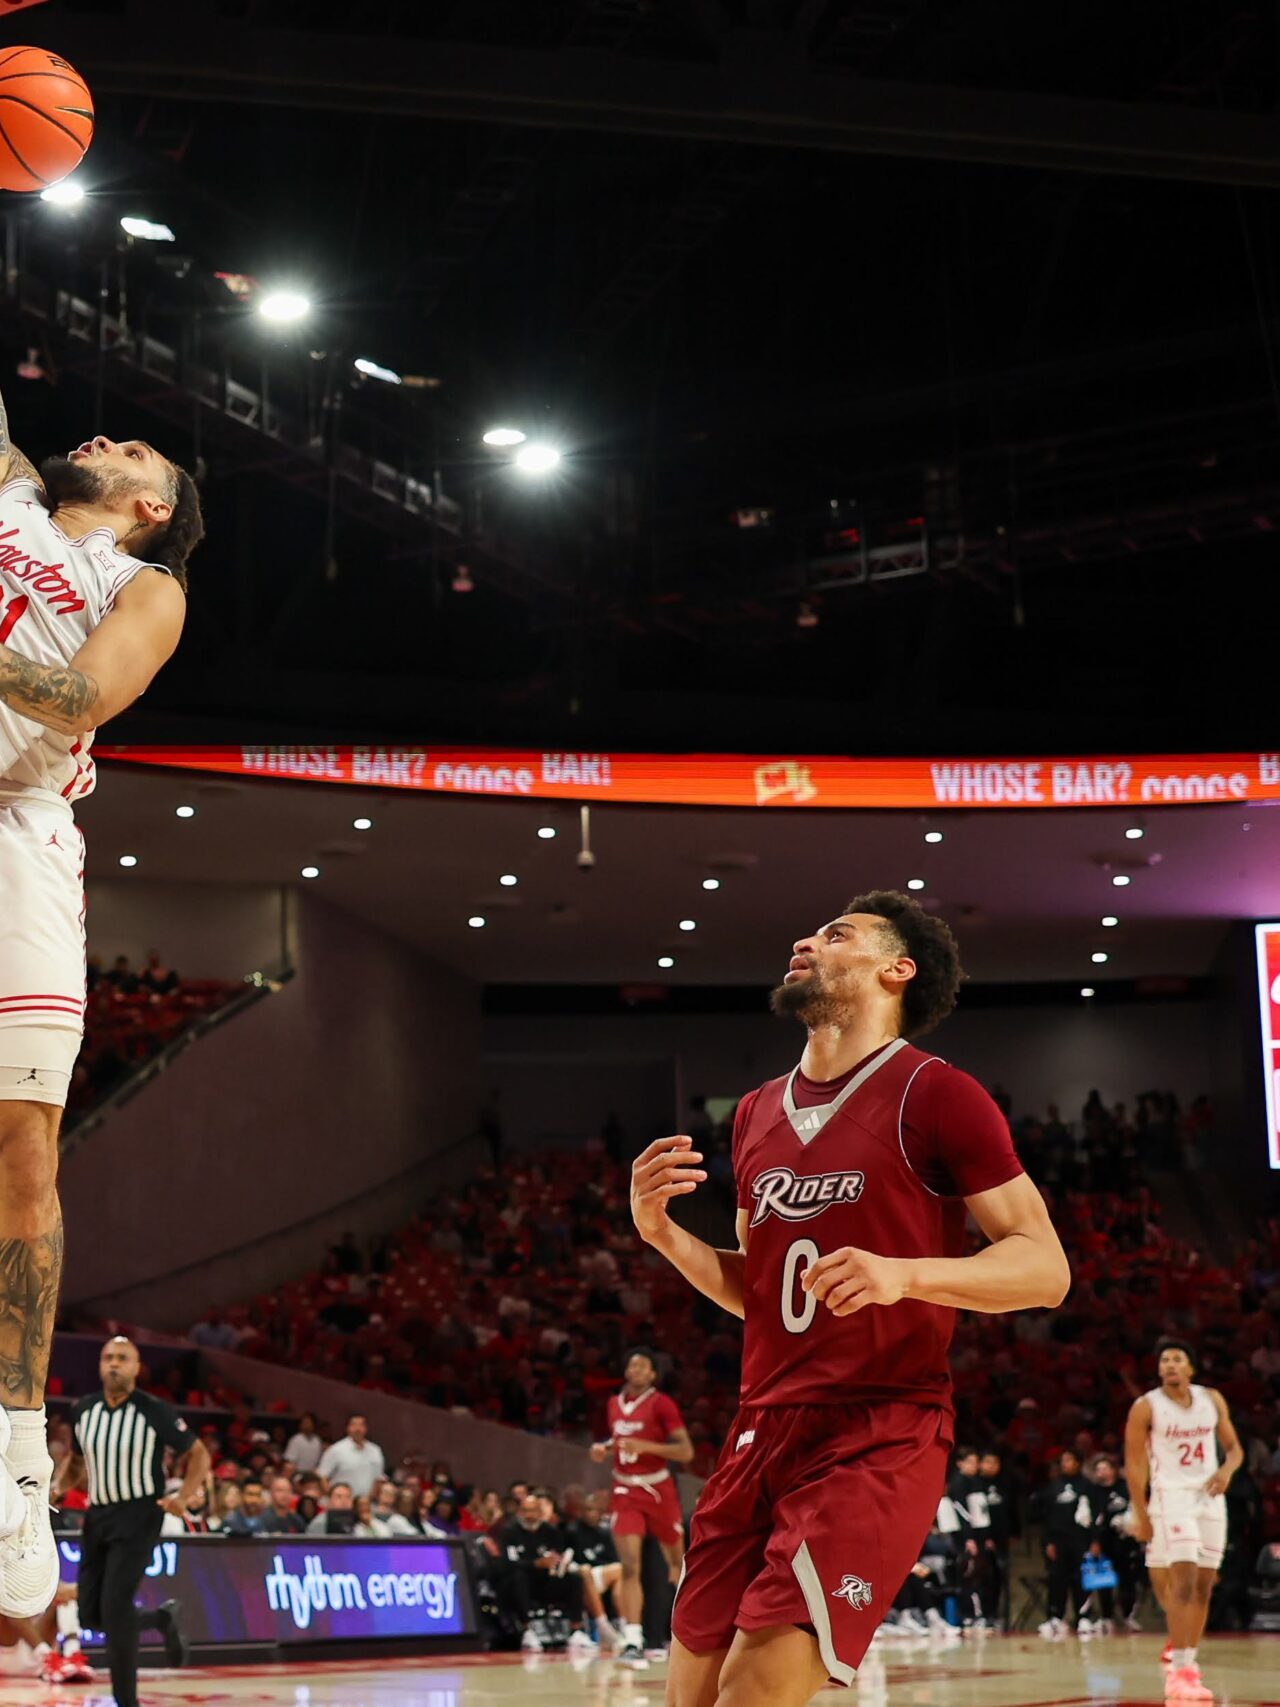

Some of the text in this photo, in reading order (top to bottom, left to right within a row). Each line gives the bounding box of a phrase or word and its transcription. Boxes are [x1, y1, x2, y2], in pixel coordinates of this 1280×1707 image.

[931, 763, 1045, 802] WHOSE
[1052, 762, 1132, 802] BAR?
[781, 1239, 821, 1333] 0
[1178, 1443, 1204, 1465] 24
[265, 1555, 457, 1629] rhythm energy
